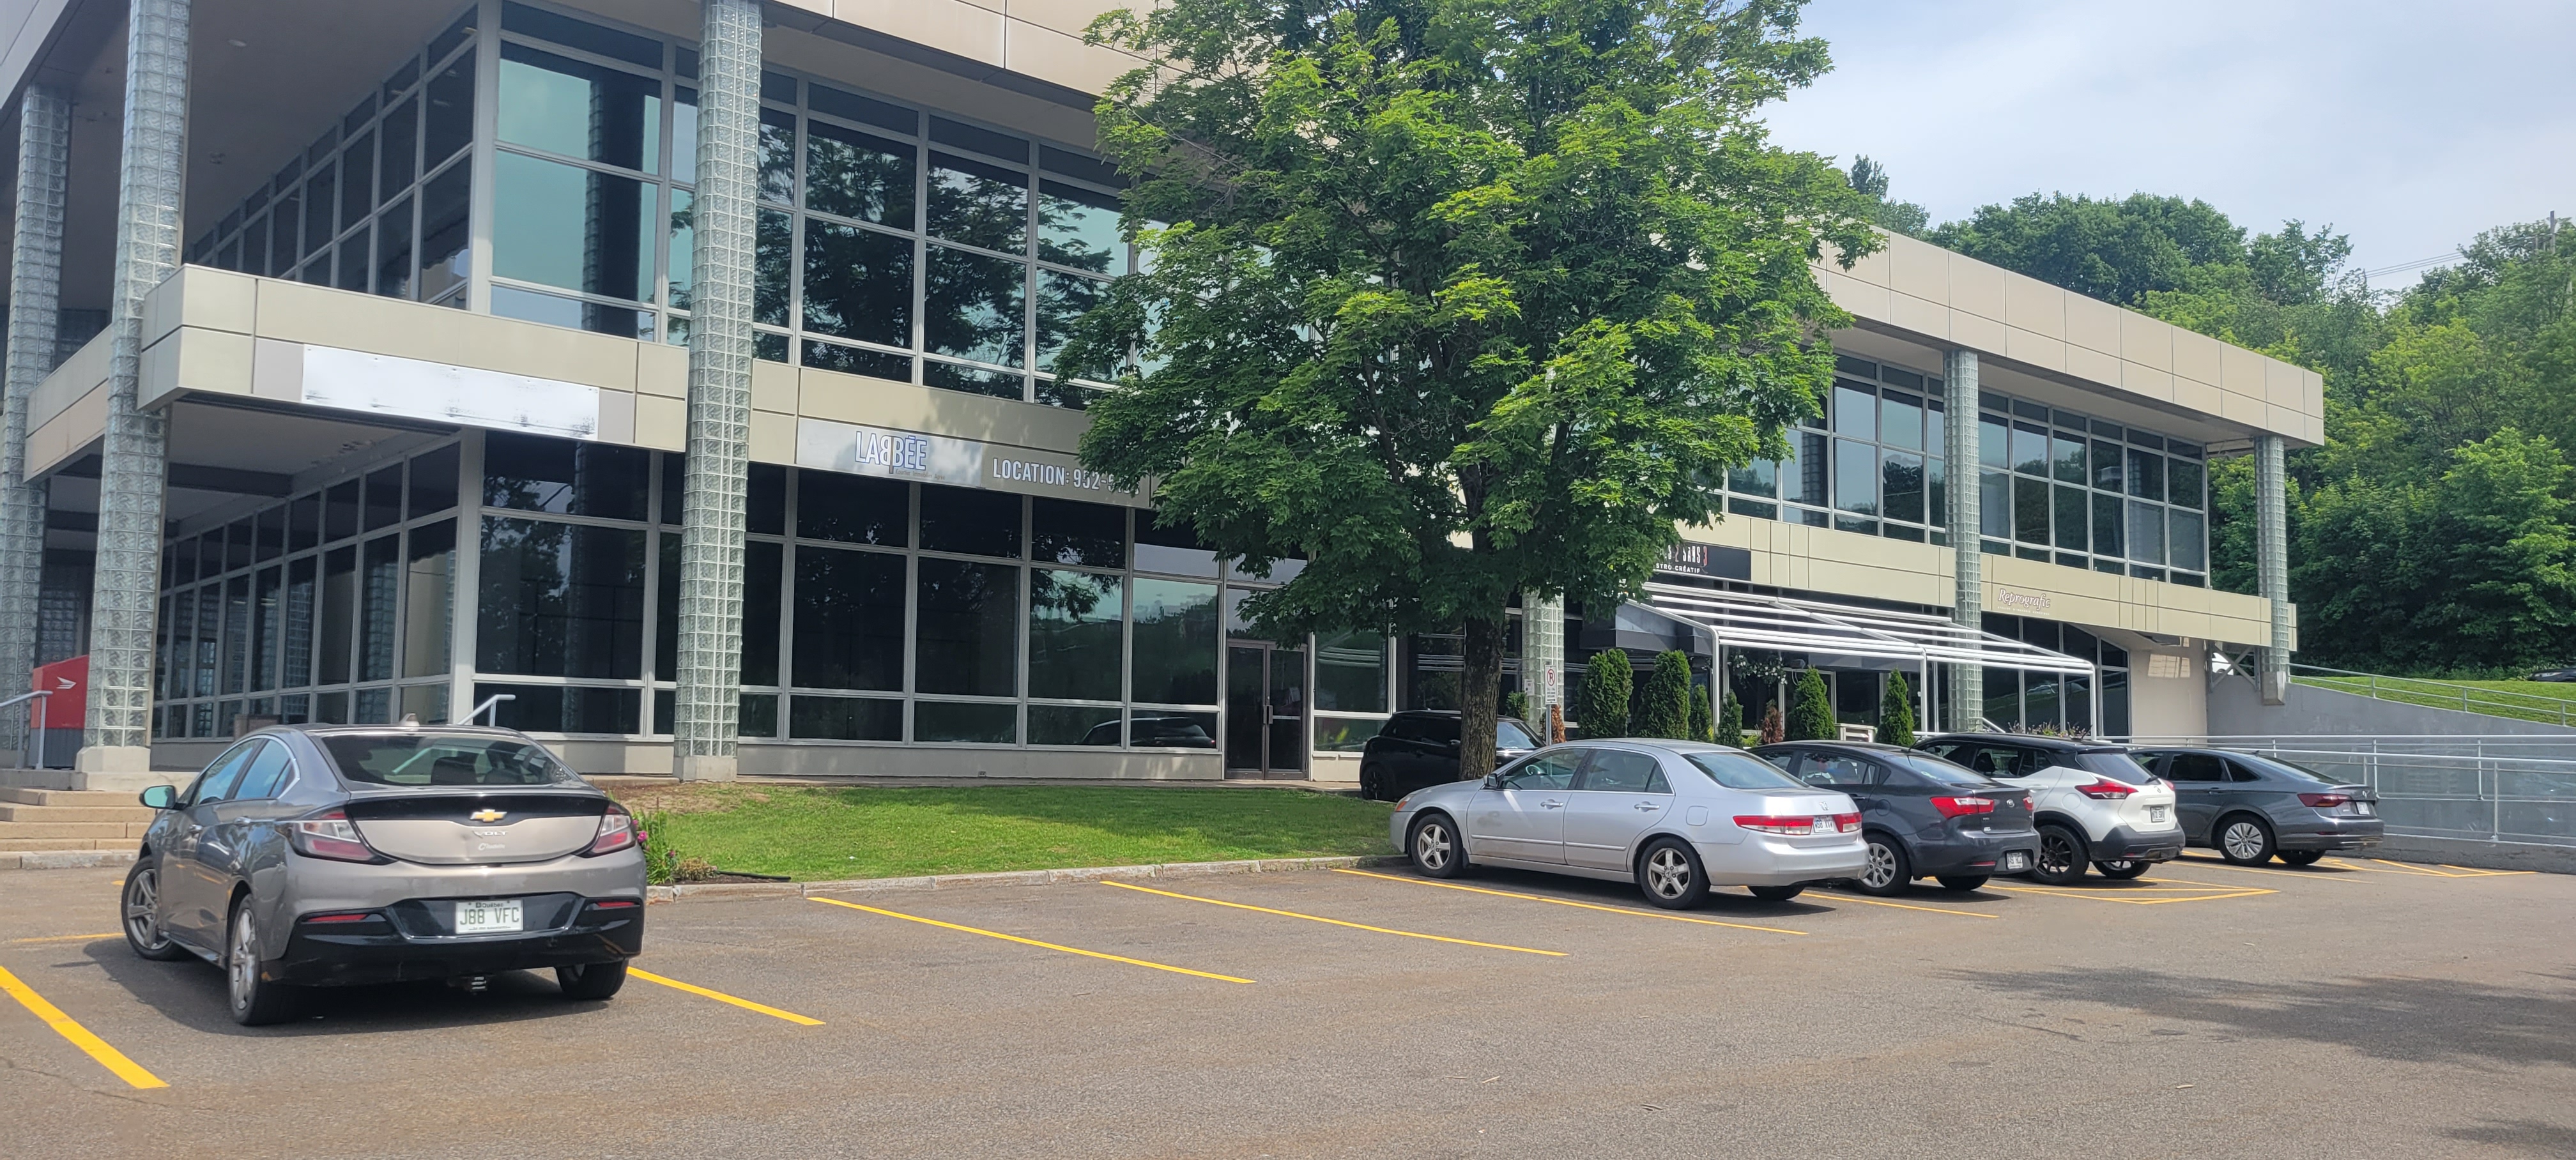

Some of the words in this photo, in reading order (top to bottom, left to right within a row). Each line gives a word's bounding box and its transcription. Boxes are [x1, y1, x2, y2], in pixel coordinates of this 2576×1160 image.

[992, 457, 1071, 486] LOCATION:
[1682, 545, 1701, 564] SANS
[1703, 546, 1708, 567] 3
[1675, 565, 1701, 574] CRÉATIF
[1998, 588, 2051, 611] Reprografic
[459, 908, 485, 925] J88
[494, 907, 519, 924] VFC
